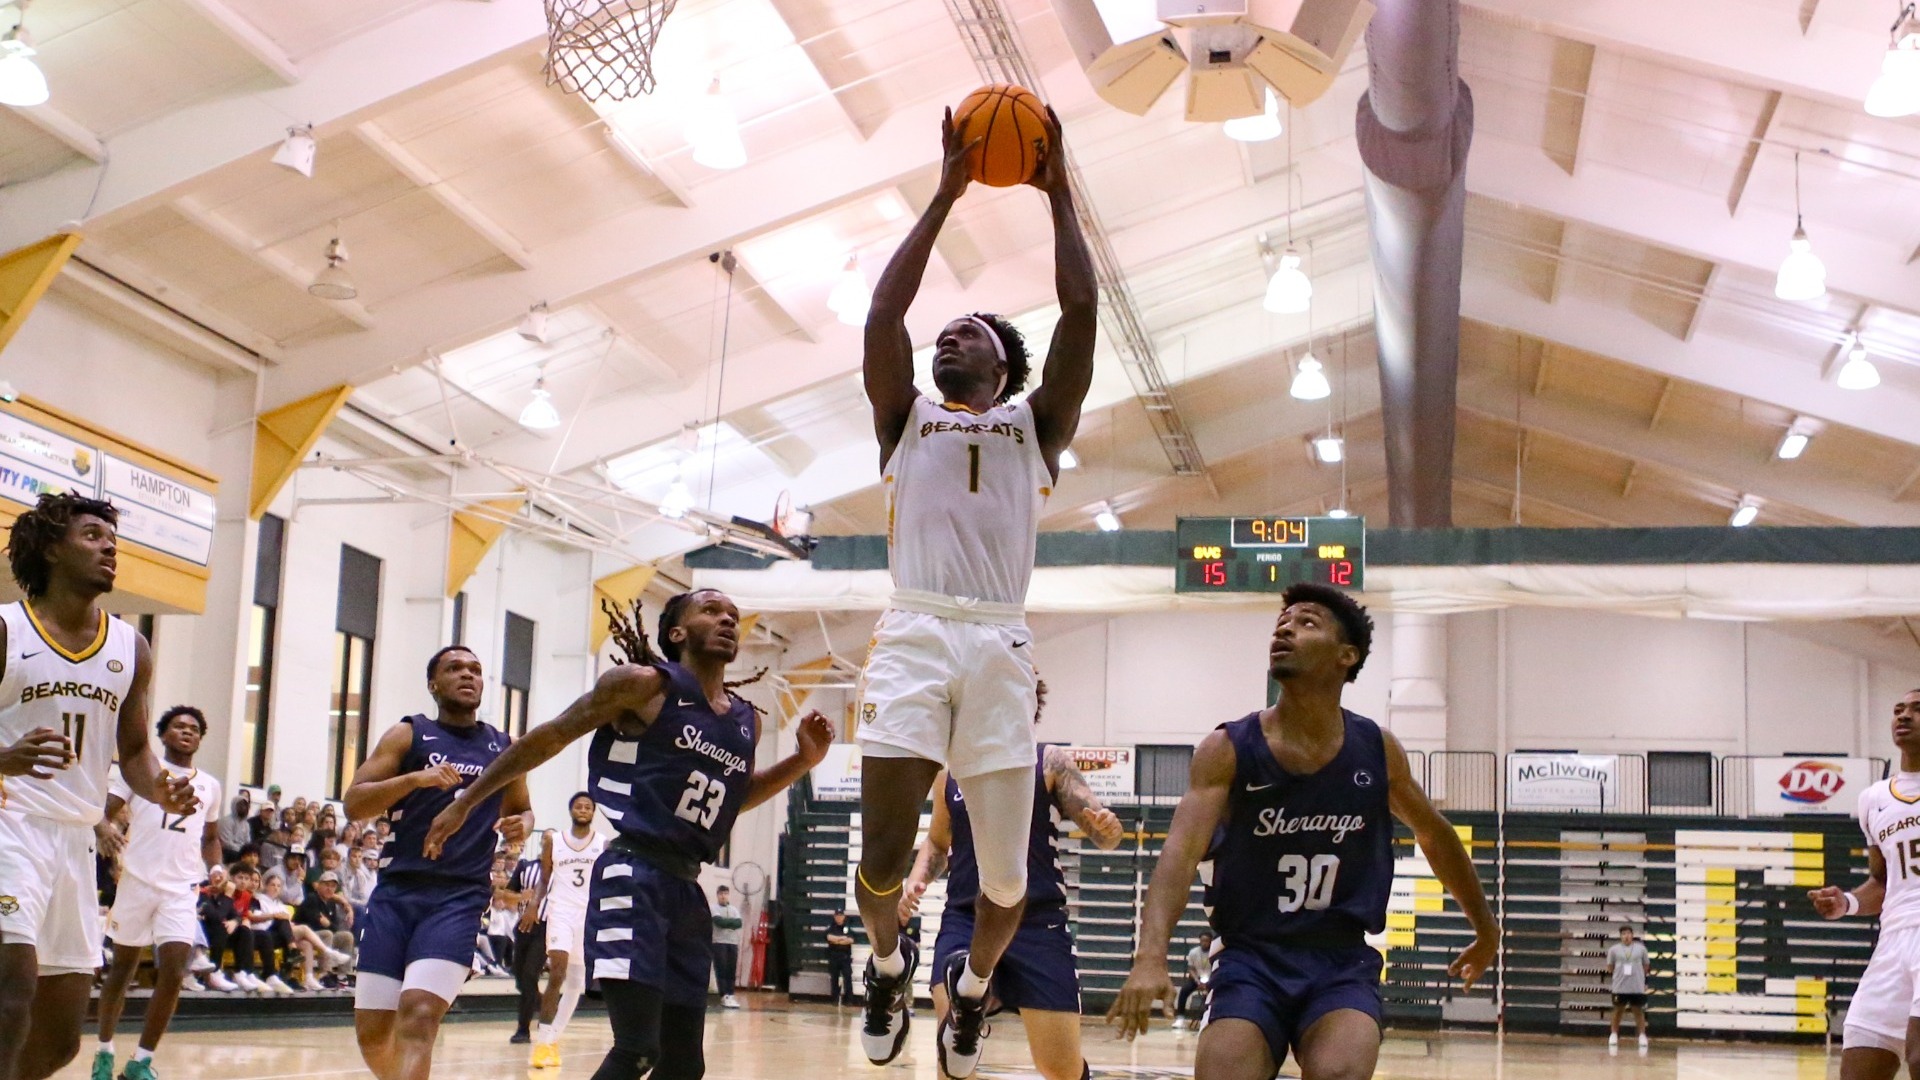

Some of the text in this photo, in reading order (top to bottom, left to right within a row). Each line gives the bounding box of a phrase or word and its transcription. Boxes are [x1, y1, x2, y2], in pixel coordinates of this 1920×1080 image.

[920, 420, 1024, 444] BEARCATS
[968, 443, 980, 494] 1
[131, 469, 190, 508] HAMPTON
[1252, 520, 1304, 543] 9:04
[1256, 553, 1283, 562] PERIOD
[1203, 562, 1226, 585] 15
[1270, 565, 1276, 582] 1
[1331, 562, 1353, 584] 12
[21, 681, 119, 712] BEARCATS
[62, 712, 86, 765] 11
[675, 724, 747, 777] Shenango
[1787, 768, 1839, 796] DQ
[674, 770, 727, 830] 23
[558, 858, 594, 867] BEARCAT
[572, 869, 585, 887] 3
[1278, 854, 1340, 913] 30
